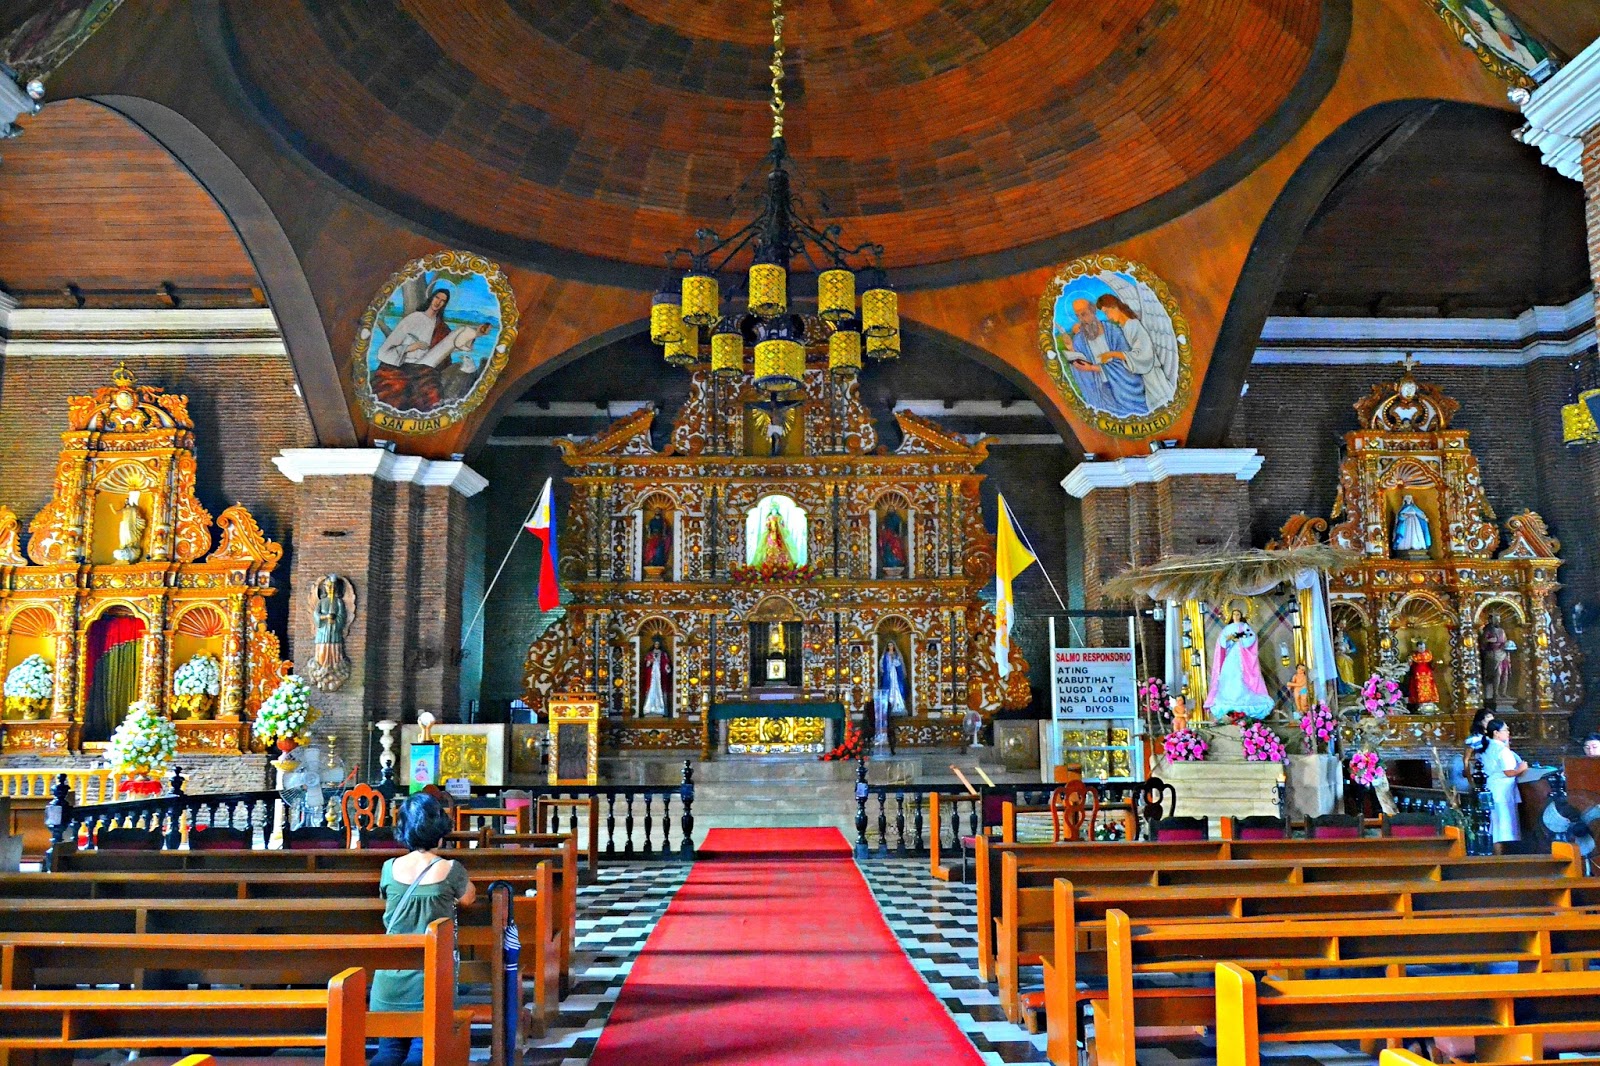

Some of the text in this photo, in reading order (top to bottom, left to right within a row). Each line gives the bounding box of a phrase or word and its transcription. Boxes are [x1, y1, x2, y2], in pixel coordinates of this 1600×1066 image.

[381, 416, 441, 431] SAN JUAN
[1105, 416, 1167, 434] SAN MATEO
[1056, 652, 1131, 662] SALMO RESPONSORIO
[1059, 686, 1093, 694] LUGOD
[1093, 695, 1130, 703] LOOBIN
[1085, 705, 1115, 713] DIYOS
